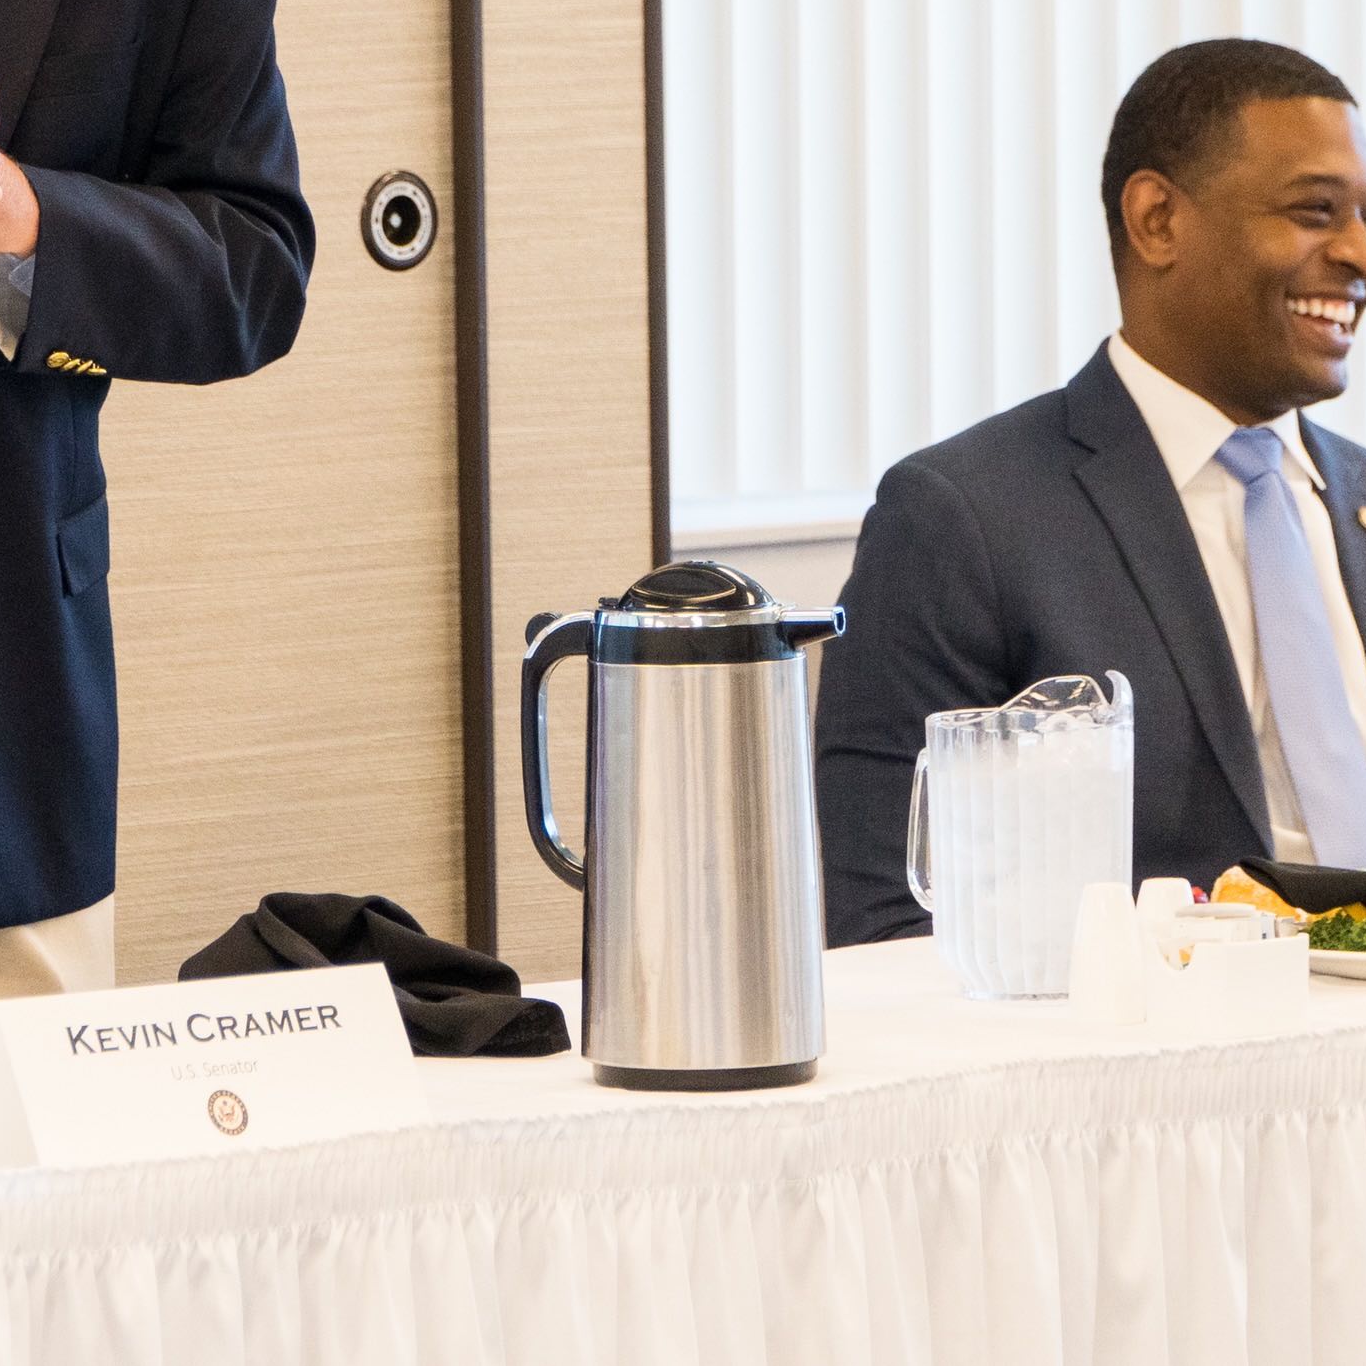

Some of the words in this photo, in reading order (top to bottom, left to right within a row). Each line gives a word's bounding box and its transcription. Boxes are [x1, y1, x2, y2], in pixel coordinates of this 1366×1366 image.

[66, 1021, 178, 1055] KEVIN
[186, 1004, 343, 1043] CRAMER
[170, 1063, 197, 1080] U.S.
[202, 1059, 259, 1078] Senator
